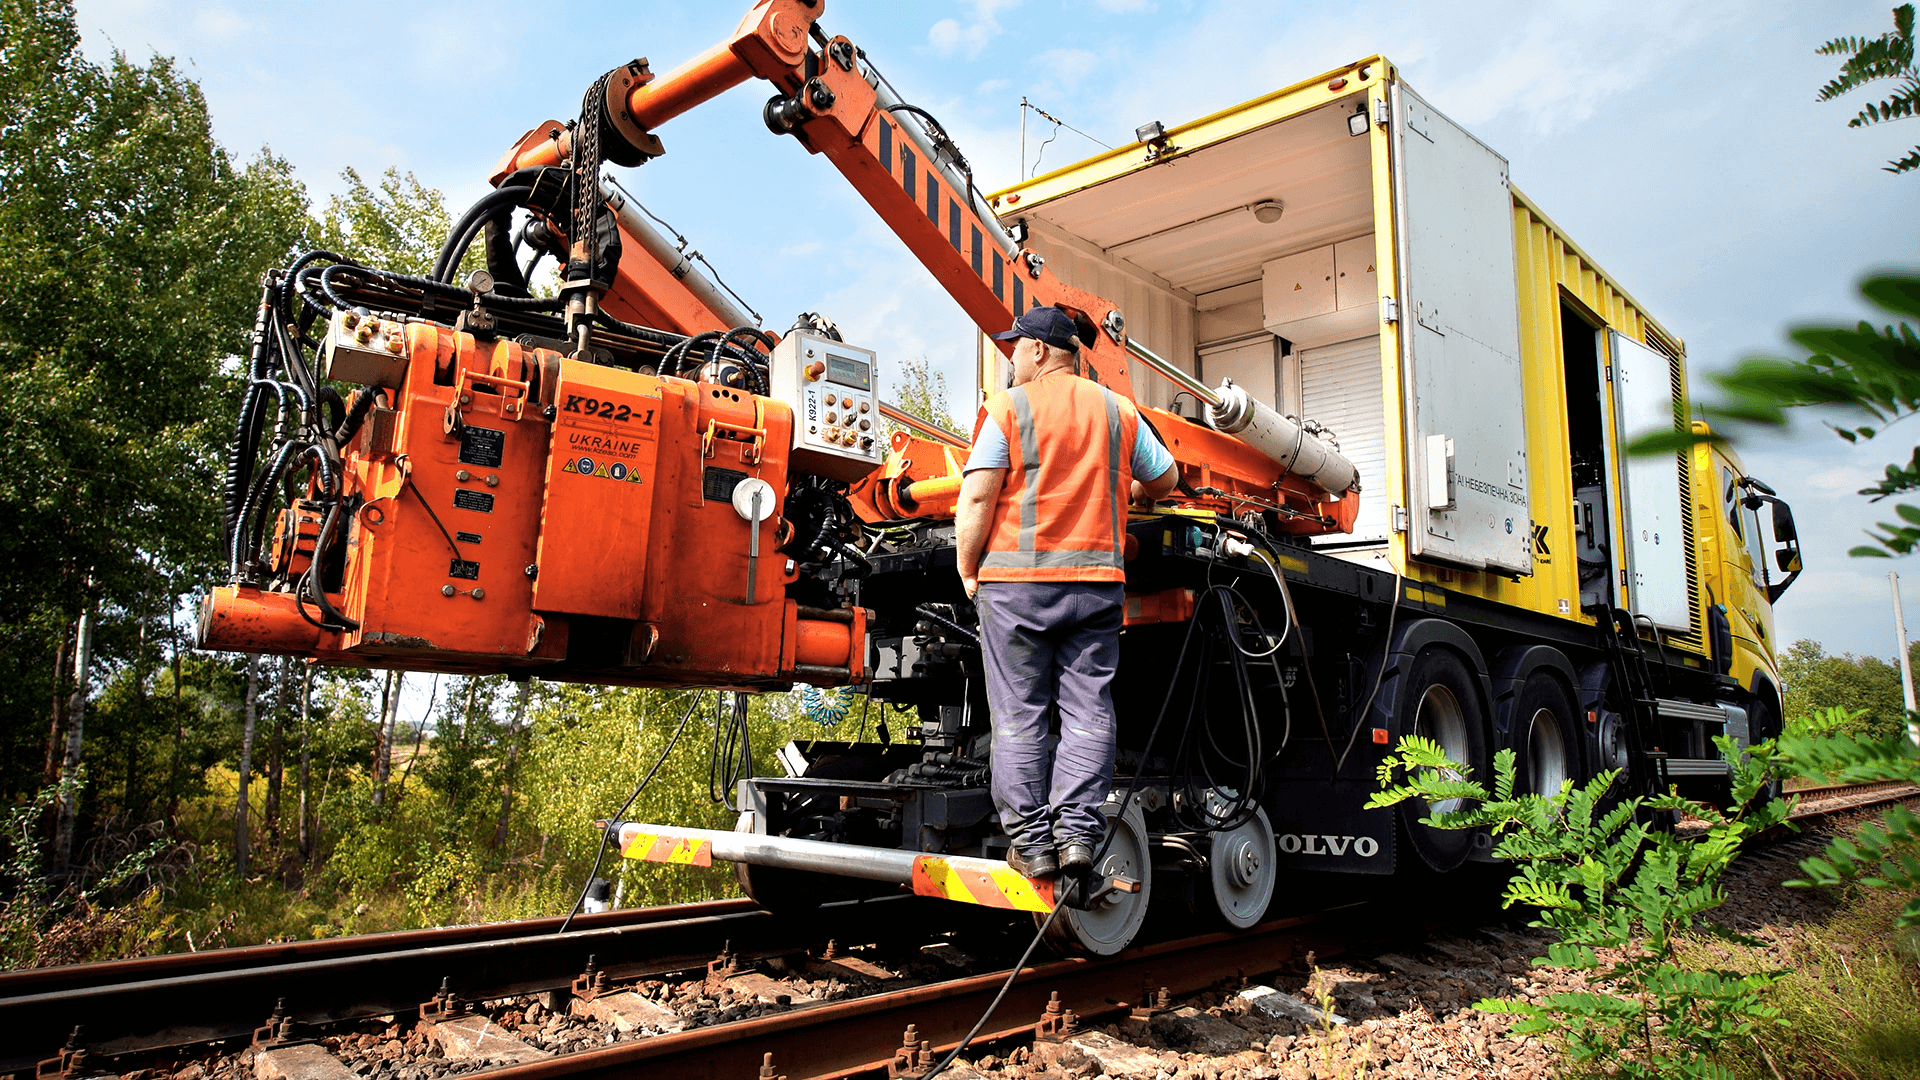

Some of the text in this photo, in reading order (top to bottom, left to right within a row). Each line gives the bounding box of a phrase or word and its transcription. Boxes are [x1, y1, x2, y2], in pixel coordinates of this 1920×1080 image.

[563, 394, 655, 427] K922-1
[808, 389, 817, 422] K922-1
[569, 433, 641, 454] UKRAINE
[571, 444, 637, 460] www.kzeso.com
[1273, 834, 1379, 857] OLVO
